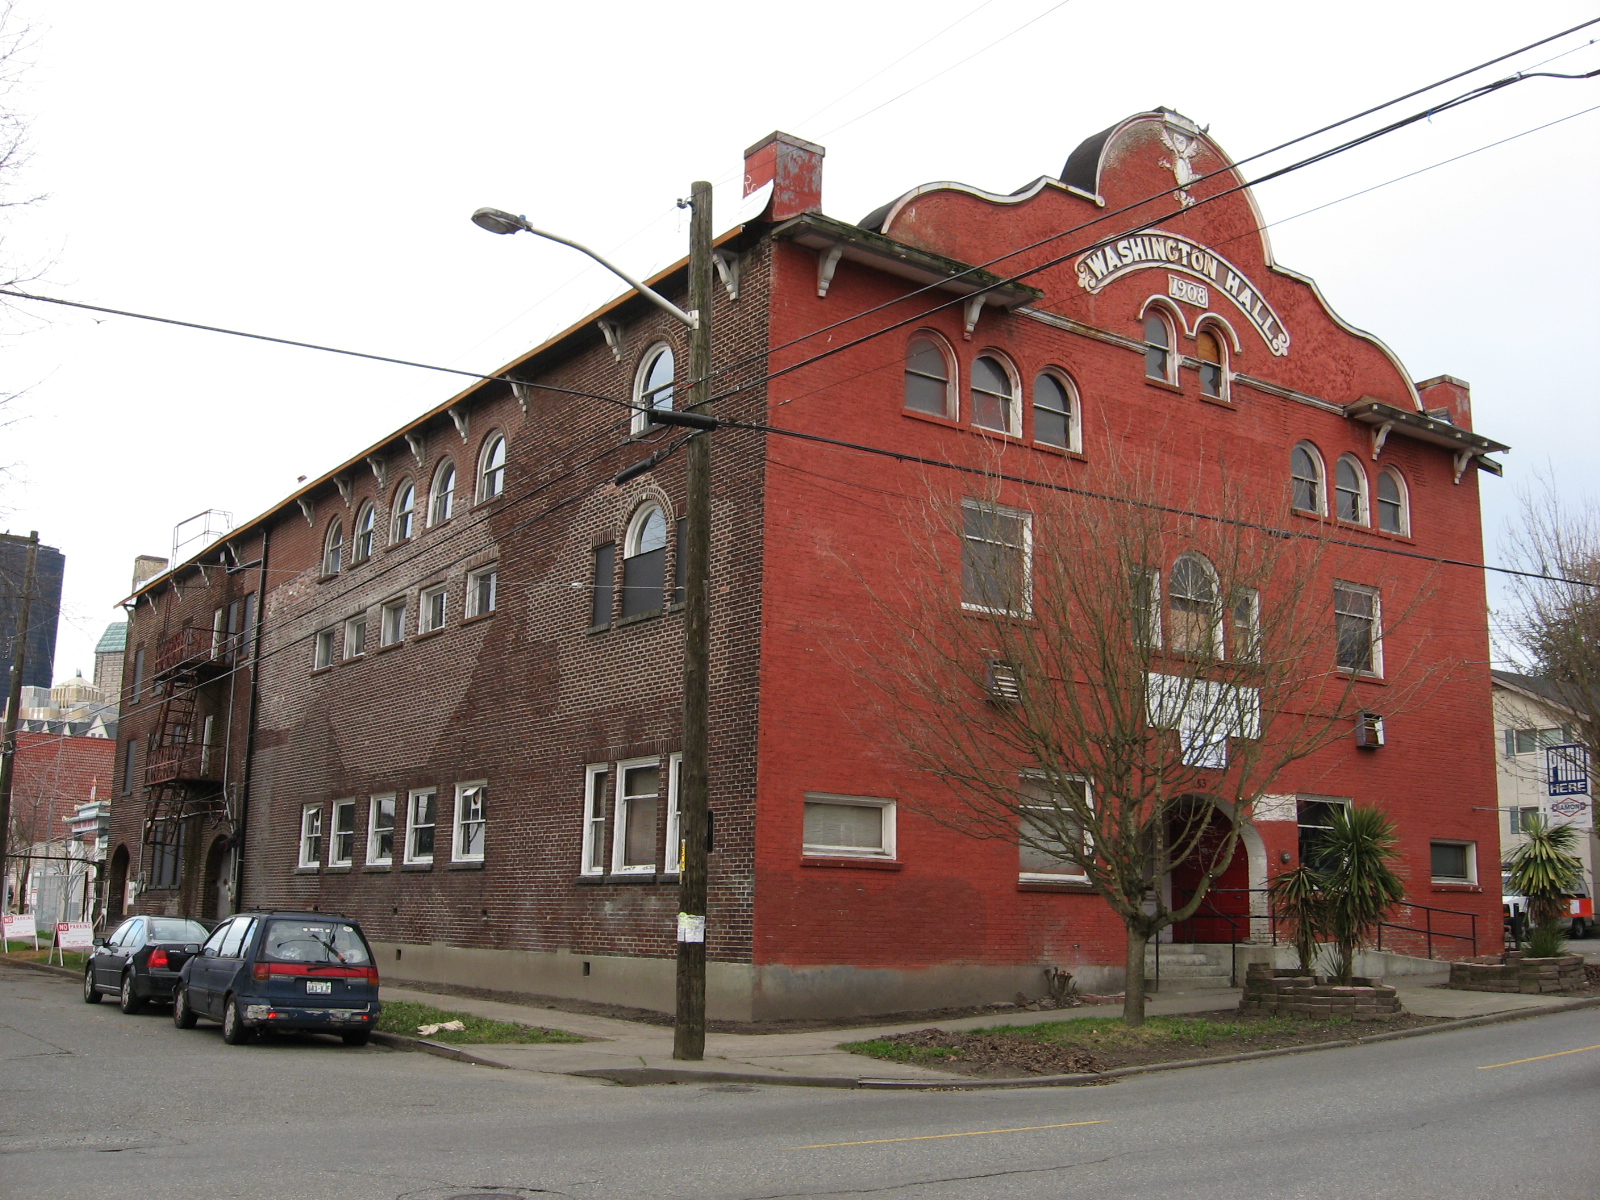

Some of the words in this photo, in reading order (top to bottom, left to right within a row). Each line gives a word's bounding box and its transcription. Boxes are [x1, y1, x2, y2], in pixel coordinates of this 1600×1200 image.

[1085, 236, 1217, 280] WASHINGTON
[1225, 270, 1276, 339] HALL
[1171, 278, 1206, 305] 1908
[1550, 782, 1586, 794] HERE
[59, 923, 68, 931] NO
